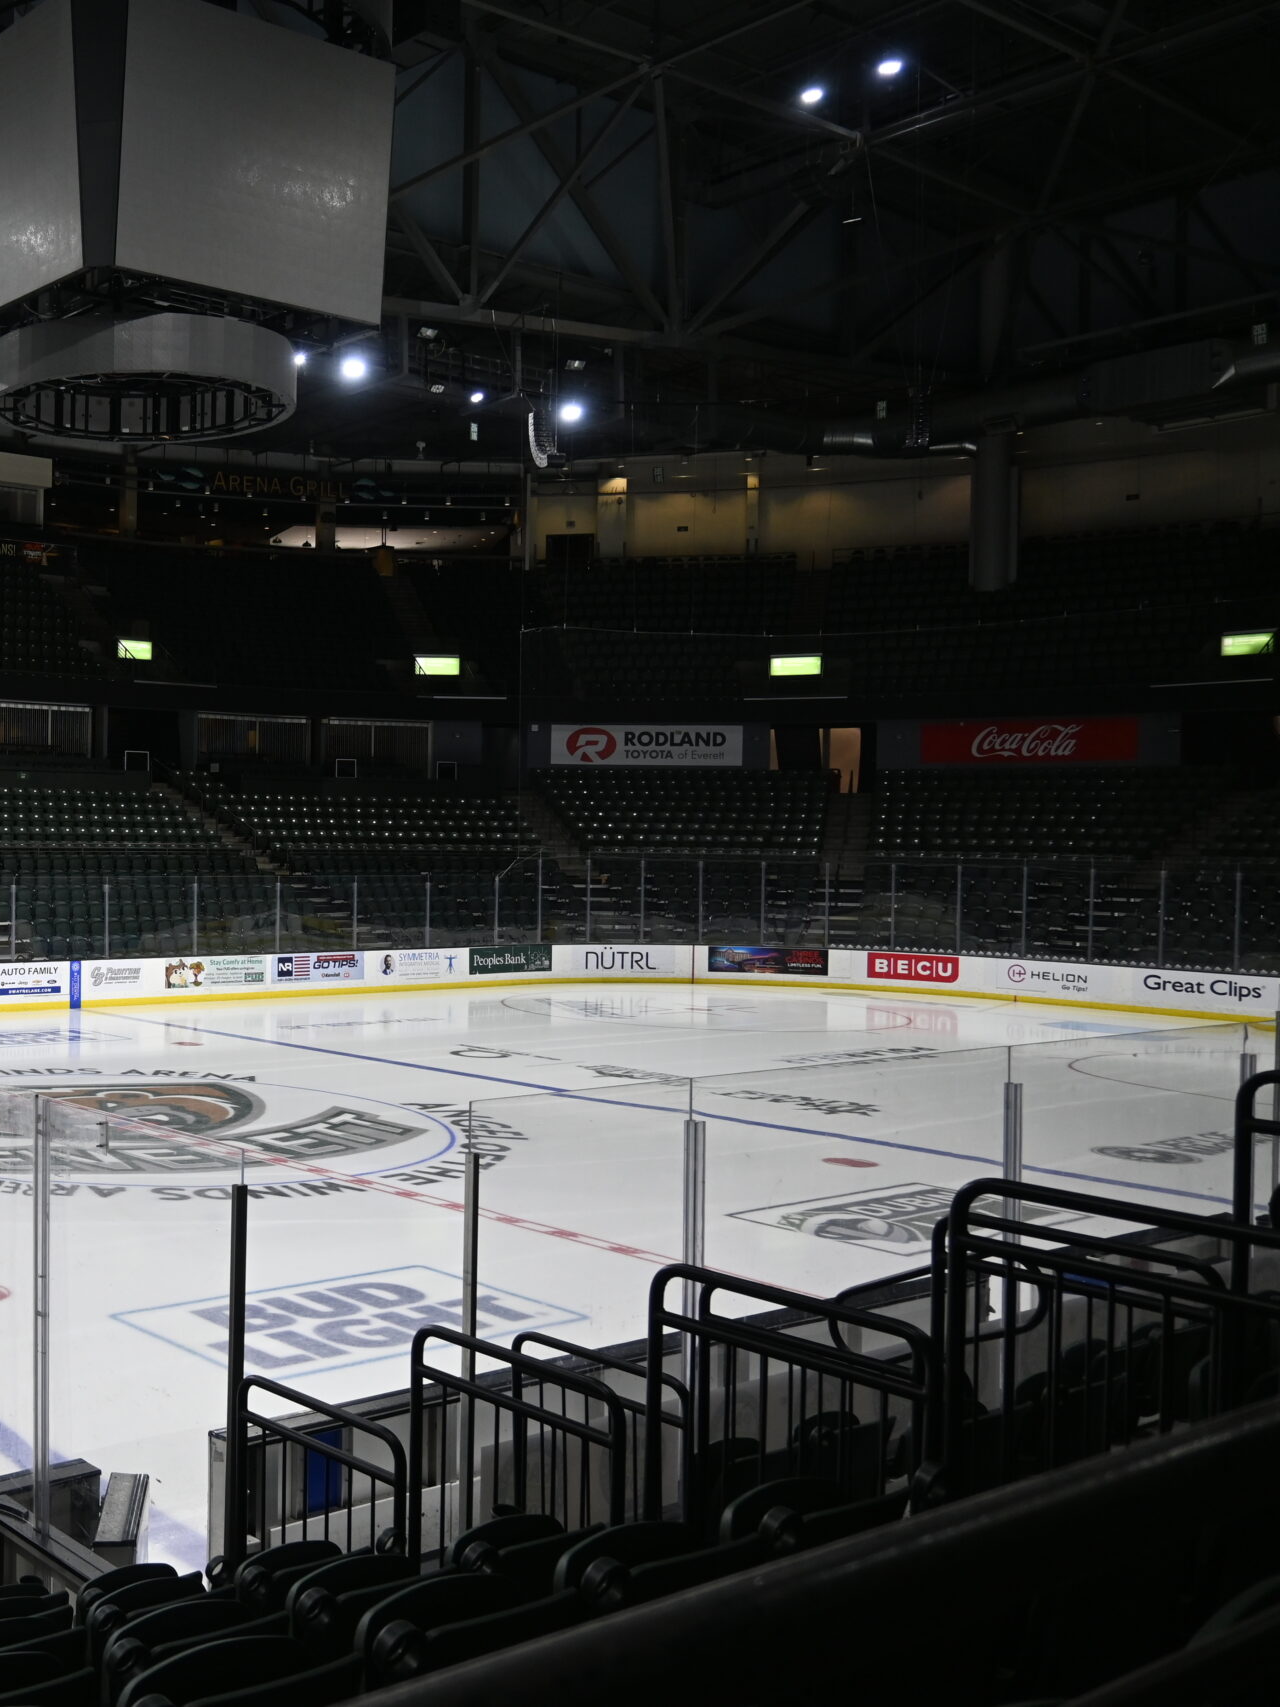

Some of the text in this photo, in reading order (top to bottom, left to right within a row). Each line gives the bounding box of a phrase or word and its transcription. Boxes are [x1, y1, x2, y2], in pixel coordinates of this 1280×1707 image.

[213, 471, 347, 498] ARENA GRILL
[624, 731, 727, 747] RODLAND
[971, 724, 1084, 758] Coca-Cola
[624, 749, 724, 760] TOYOTA of Everett
[313, 959, 359, 969] GO TIPS!
[399, 952, 440, 962] SYMMETRIA
[473, 953, 527, 968] Peoples Bank
[1, 967, 25, 976] AUTO
[28, 966, 58, 975] FAMILY
[278, 962, 292, 971] NR
[1031, 971, 1087, 983] HELION
[1143, 974, 1262, 1001] Great Clips
[122, 1069, 257, 1082] ARENA
[380, 1160, 466, 1186] THE
[190, 1281, 426, 1334] BUD
[206, 1294, 536, 1370] LIGHT
